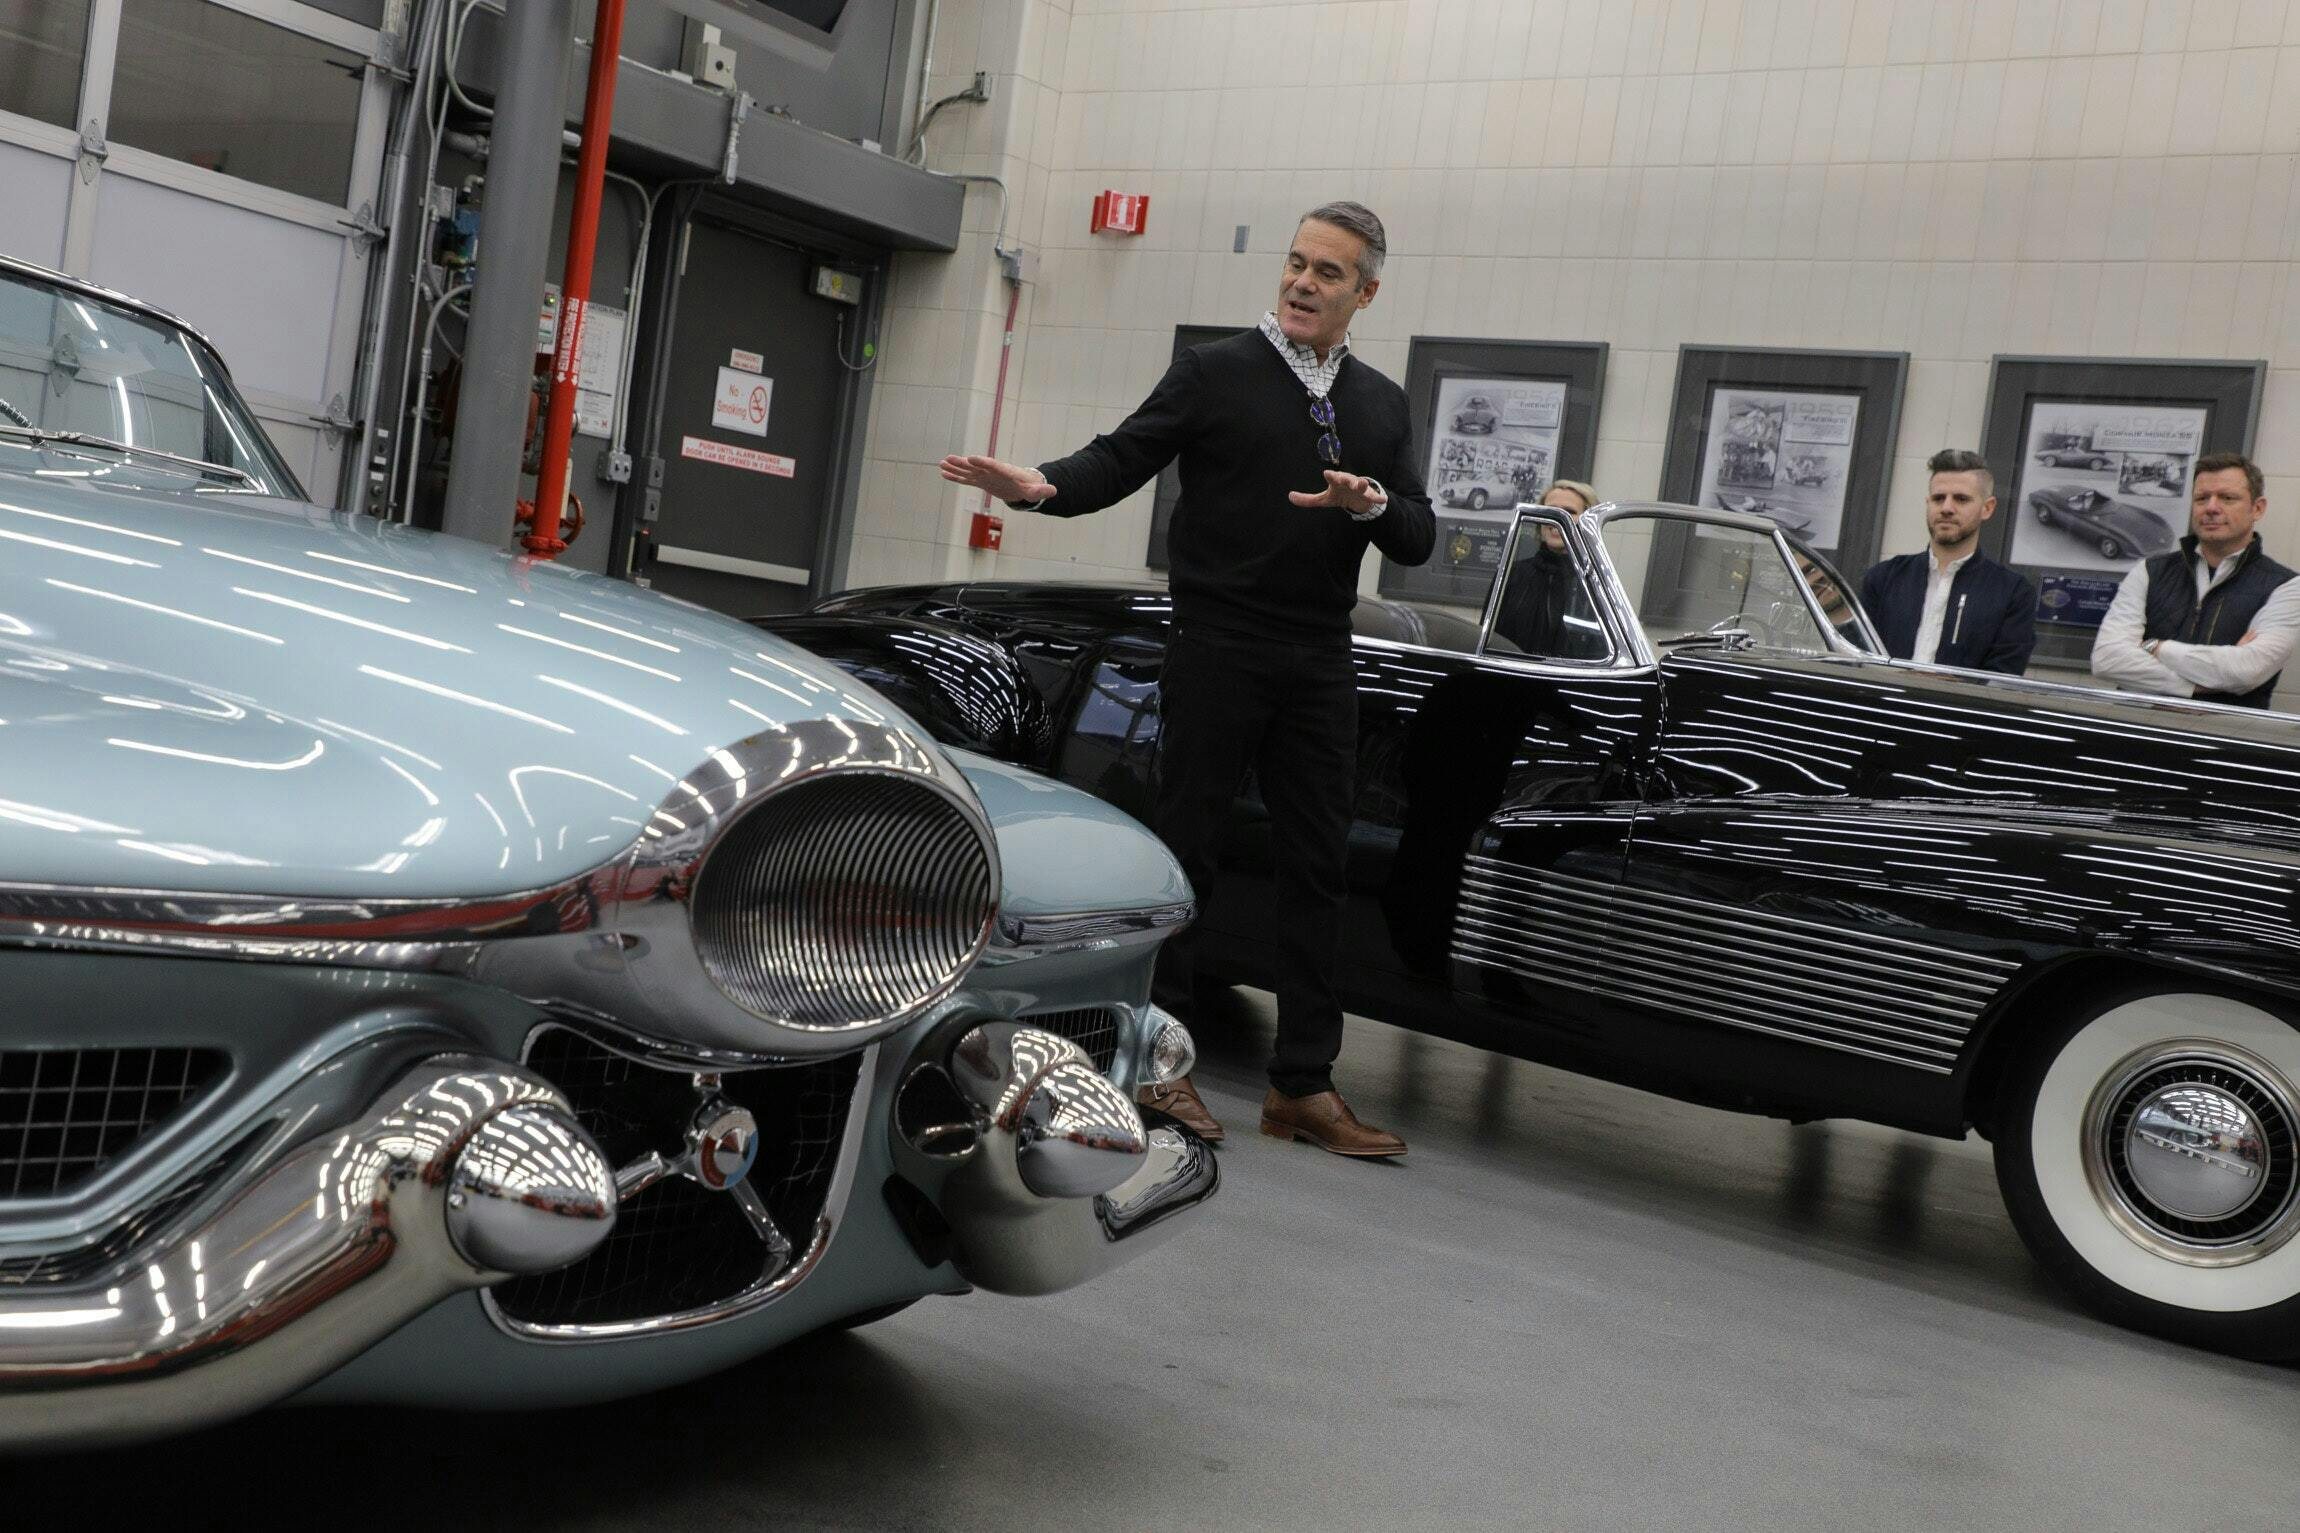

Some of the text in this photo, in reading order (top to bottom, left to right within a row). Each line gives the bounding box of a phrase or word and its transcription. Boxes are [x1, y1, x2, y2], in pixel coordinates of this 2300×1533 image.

[729, 383, 739, 397] No
[717, 399, 747, 420] Smoking
[685, 447, 703, 456] DOOR
[704, 451, 716, 459] CAN
[727, 456, 750, 466] OPENED
[764, 463, 791, 475] SECONDS
[699, 442, 780, 465] PUSH UNTIL ALARM SOUNDS
